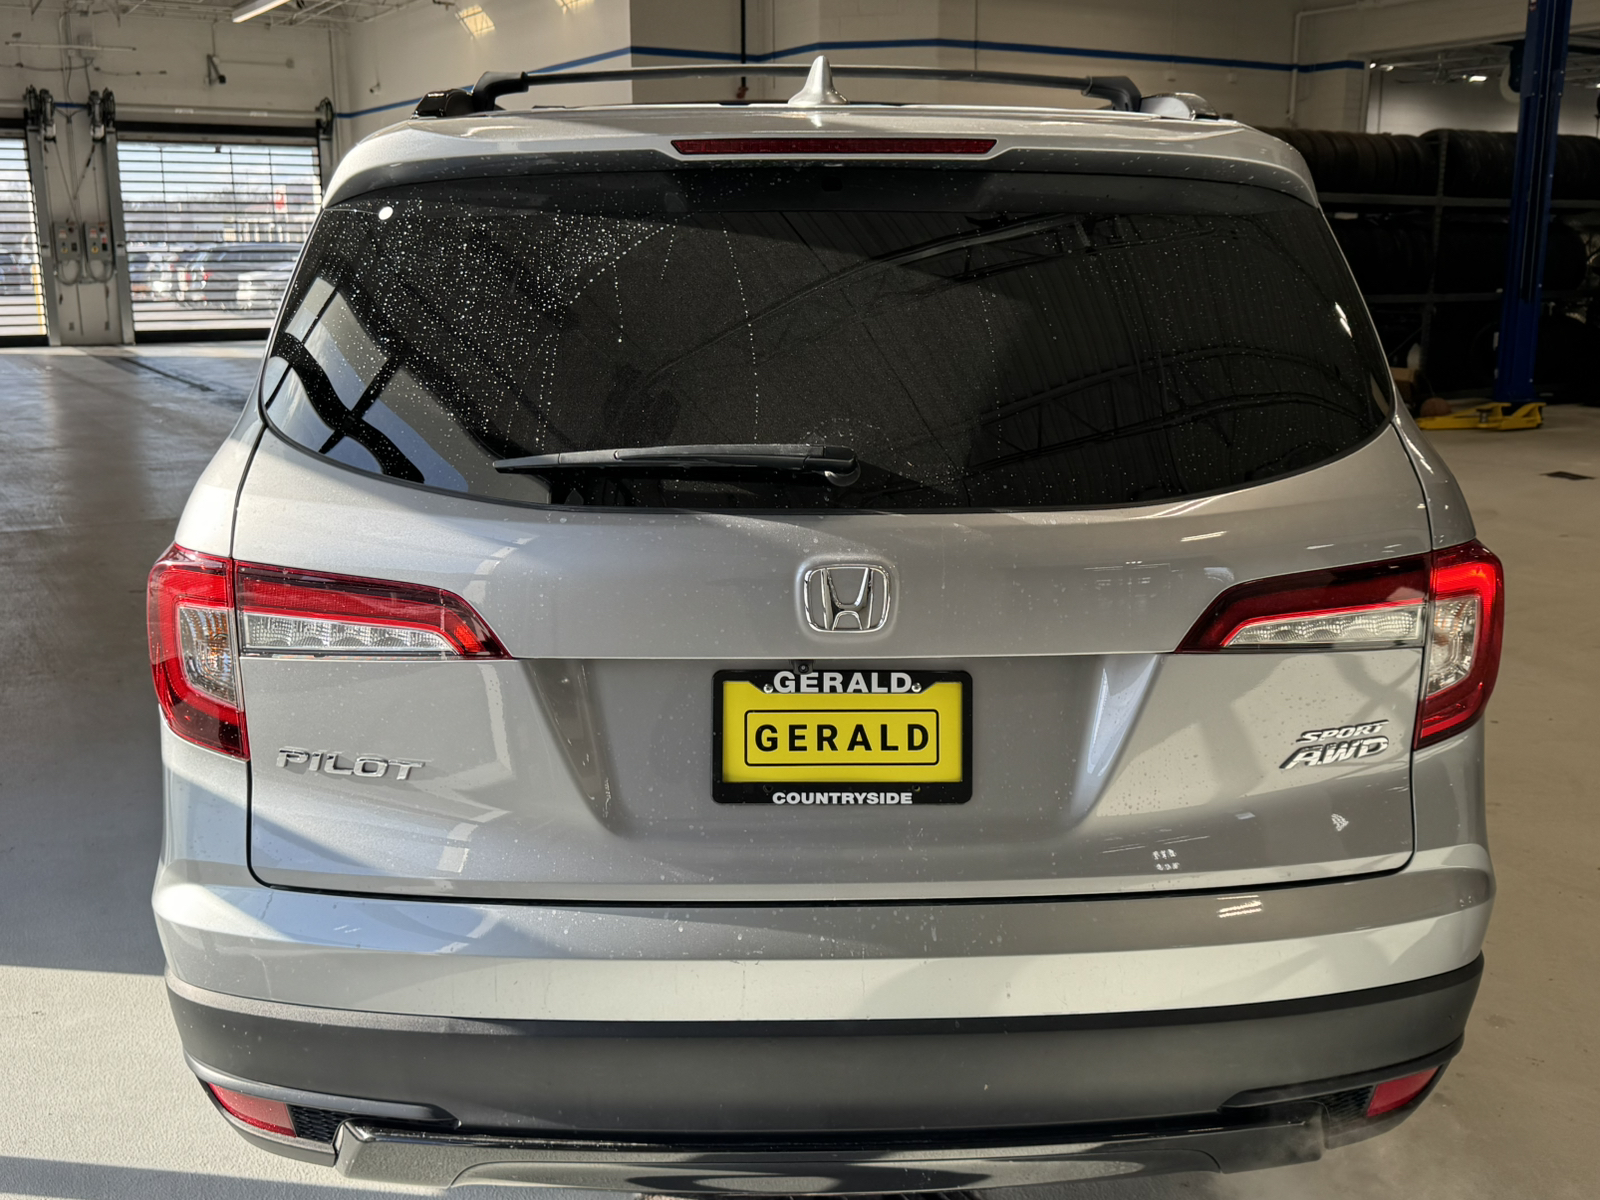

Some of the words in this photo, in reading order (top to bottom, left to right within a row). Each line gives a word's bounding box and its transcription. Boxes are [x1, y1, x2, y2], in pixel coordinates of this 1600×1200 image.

[773, 670, 912, 694] GERALD
[754, 723, 930, 753] GERALD
[1296, 719, 1389, 743] SPORT
[276, 746, 430, 781] PILOT
[1279, 735, 1389, 770] AWD
[772, 791, 913, 805] COUNTRYSIDE
